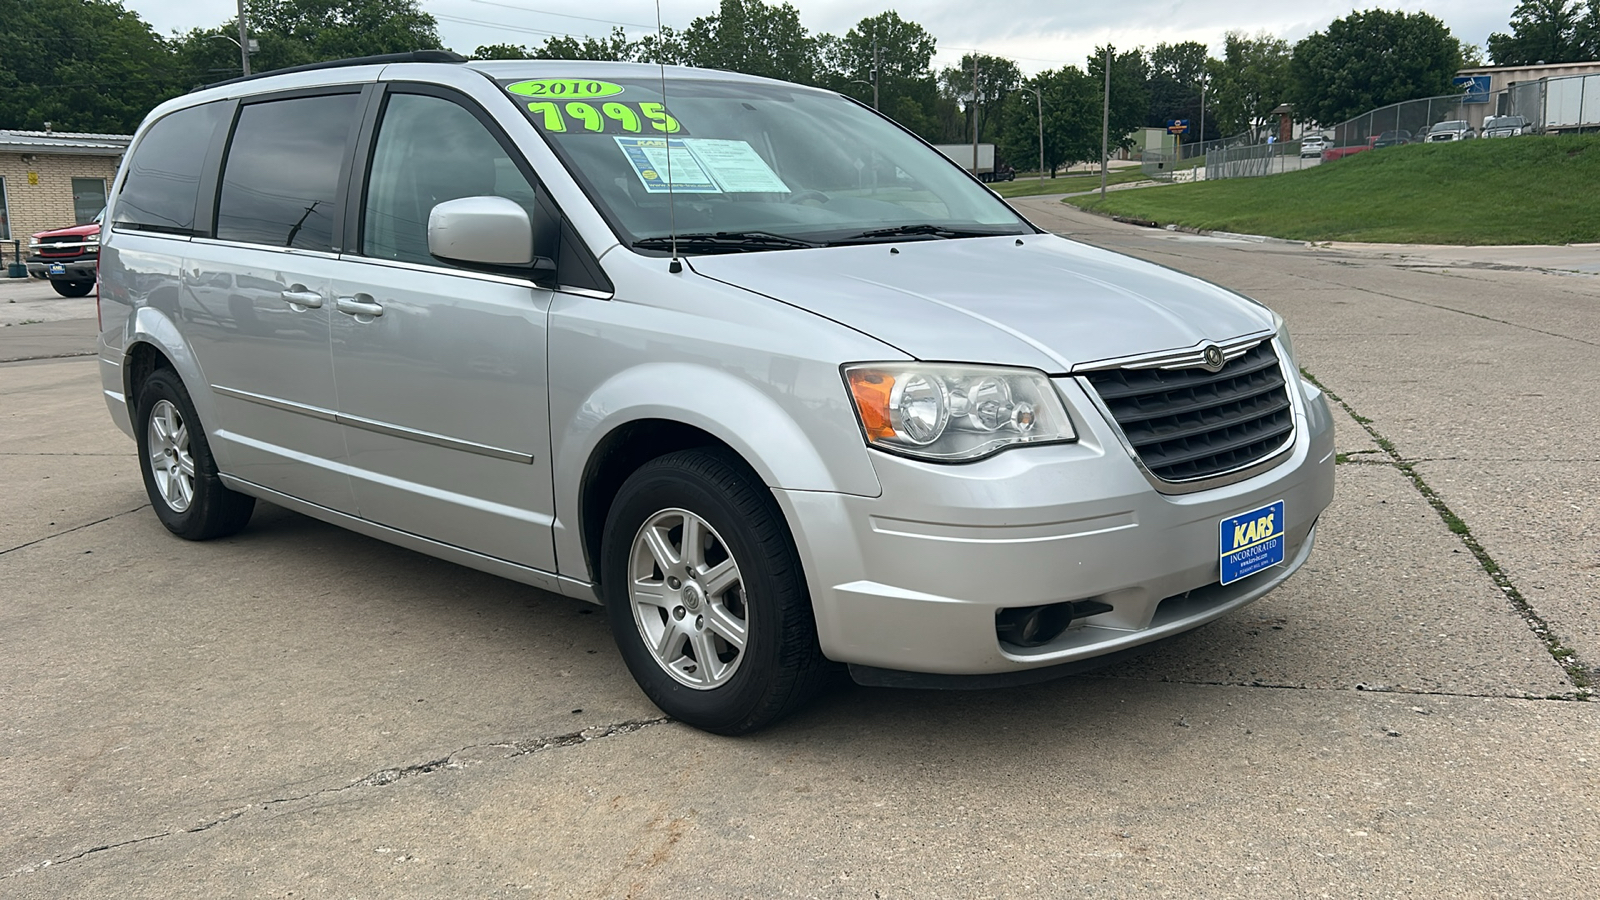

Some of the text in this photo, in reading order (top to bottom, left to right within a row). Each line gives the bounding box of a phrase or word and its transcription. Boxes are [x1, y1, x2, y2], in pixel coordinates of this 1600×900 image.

[530, 82, 603, 95] 2010
[527, 101, 680, 134] 7995
[1233, 513, 1275, 549] KARS
[1230, 539, 1277, 564] INCORPORATED
